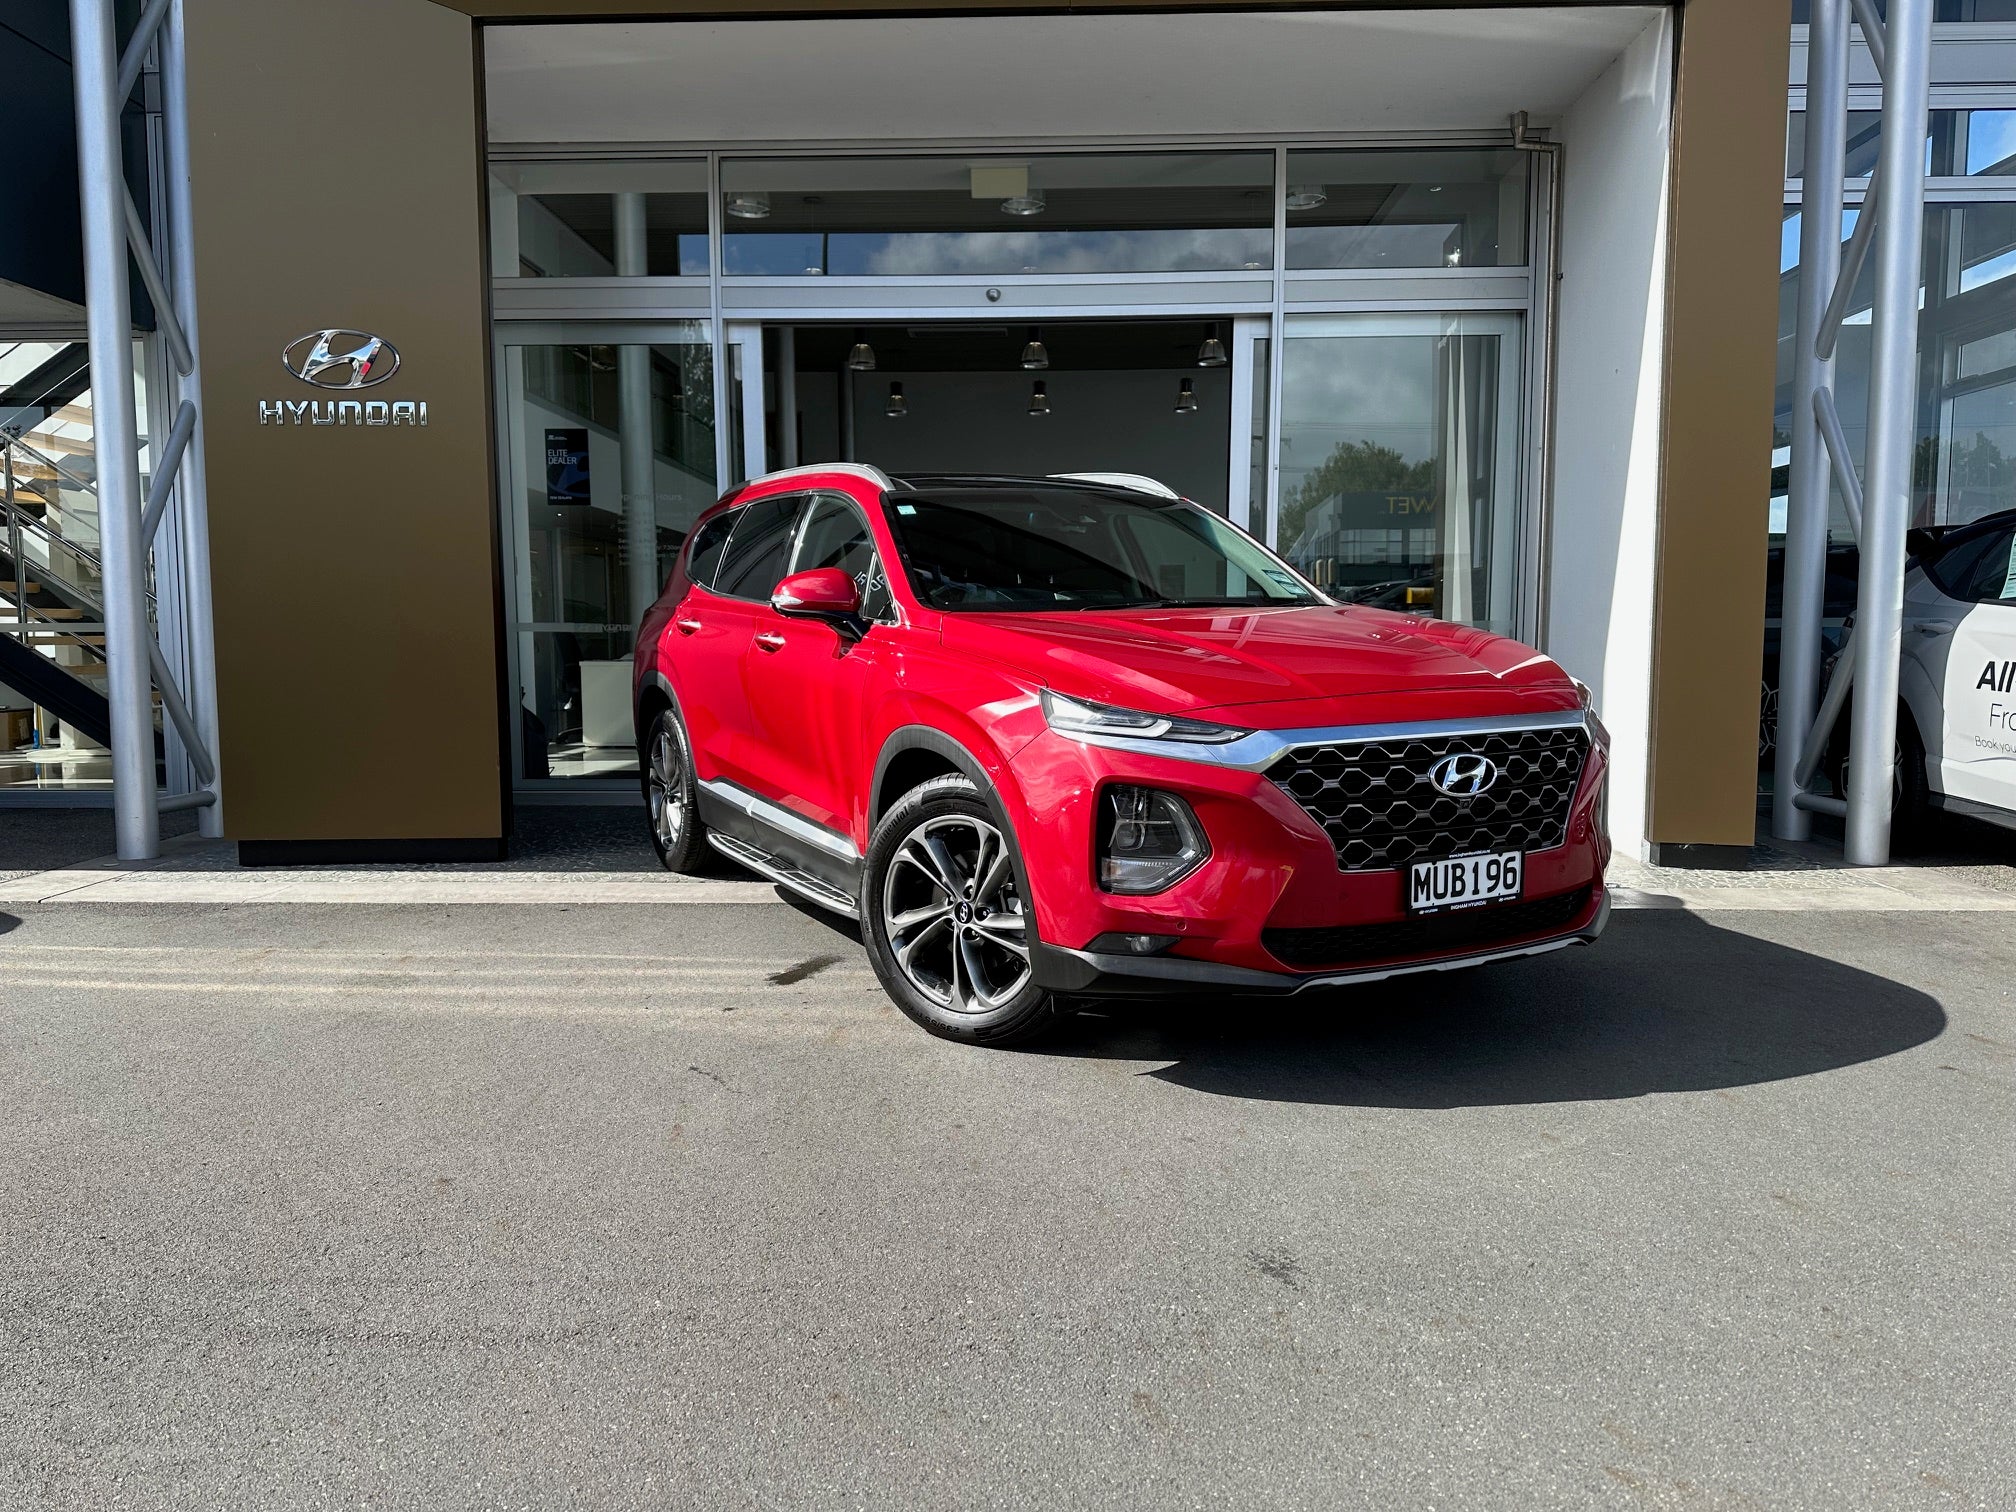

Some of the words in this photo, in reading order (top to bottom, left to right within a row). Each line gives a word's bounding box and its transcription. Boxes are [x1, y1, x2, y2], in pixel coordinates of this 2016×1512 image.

[259, 400, 428, 426] HYUNDAI
[547, 449, 569, 457] ELITE
[548, 456, 578, 465] DEALER
[1975, 735, 1999, 751] Book
[1413, 855, 1517, 903] MUB196
